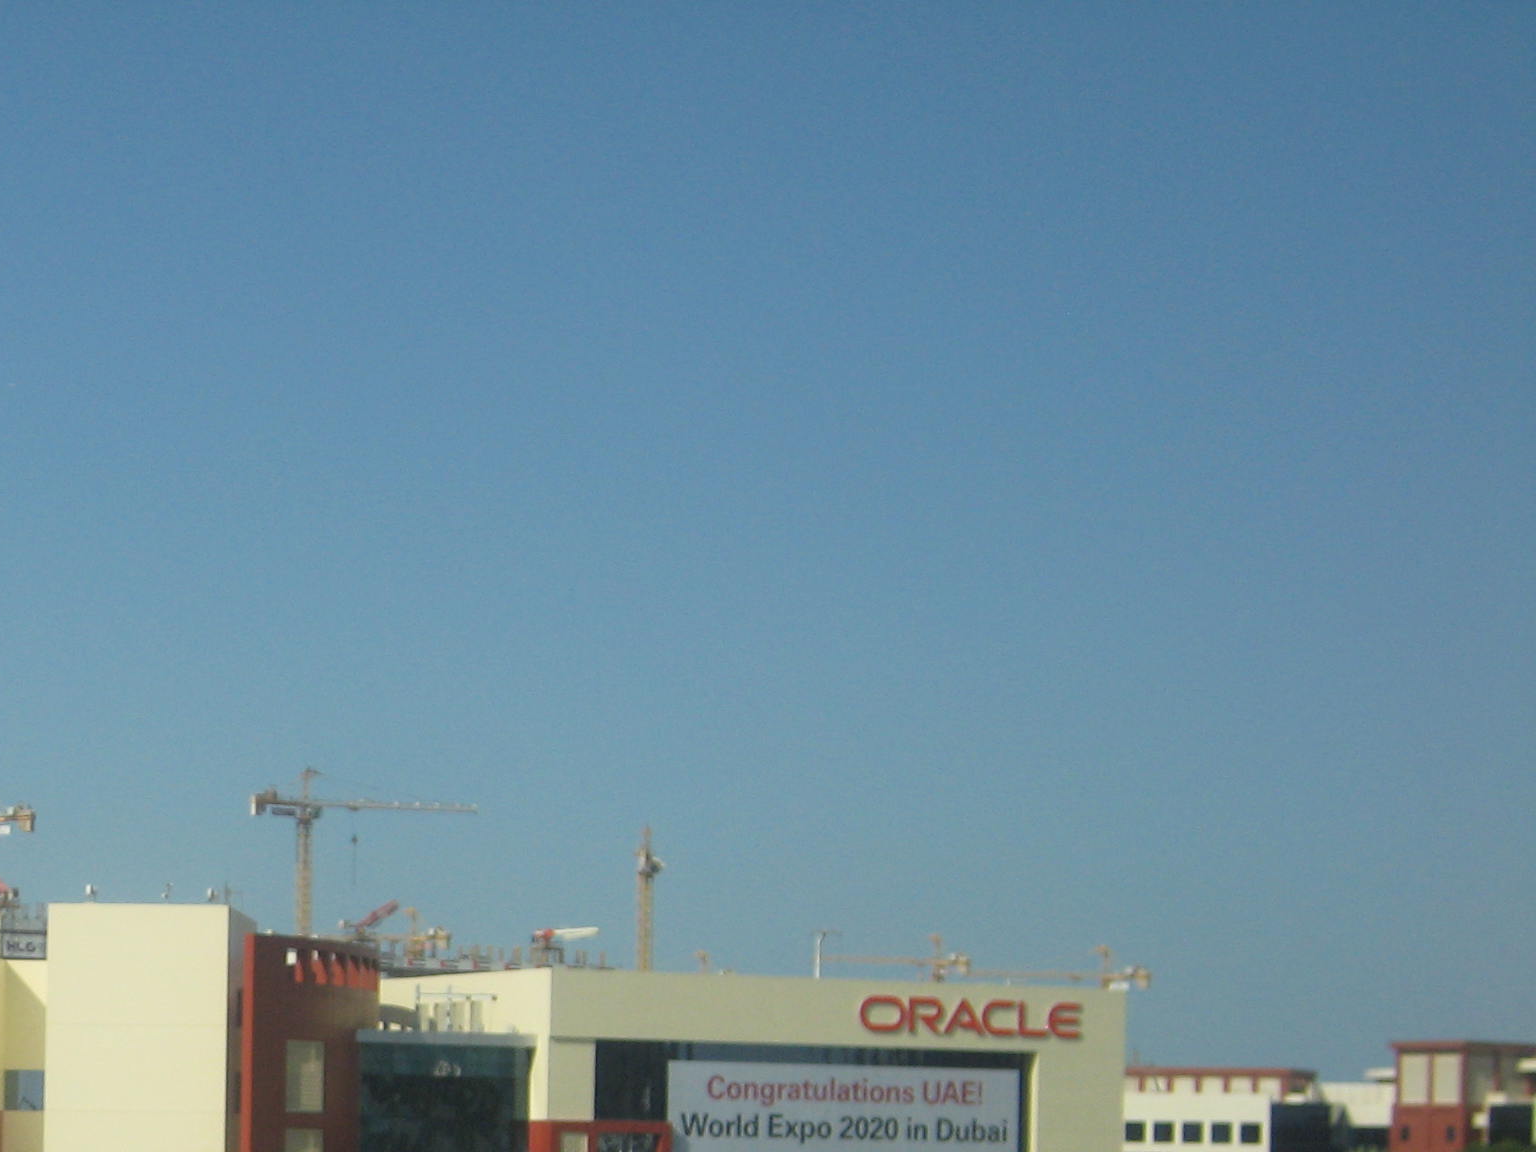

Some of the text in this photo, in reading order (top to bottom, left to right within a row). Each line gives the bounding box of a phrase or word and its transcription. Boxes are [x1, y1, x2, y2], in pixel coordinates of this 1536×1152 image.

[860, 995, 1083, 1039] ORACLE
[707, 1075, 983, 1107] Congratulations UAE!
[681, 1112, 1009, 1144] World Expo 2020 in Dubai
